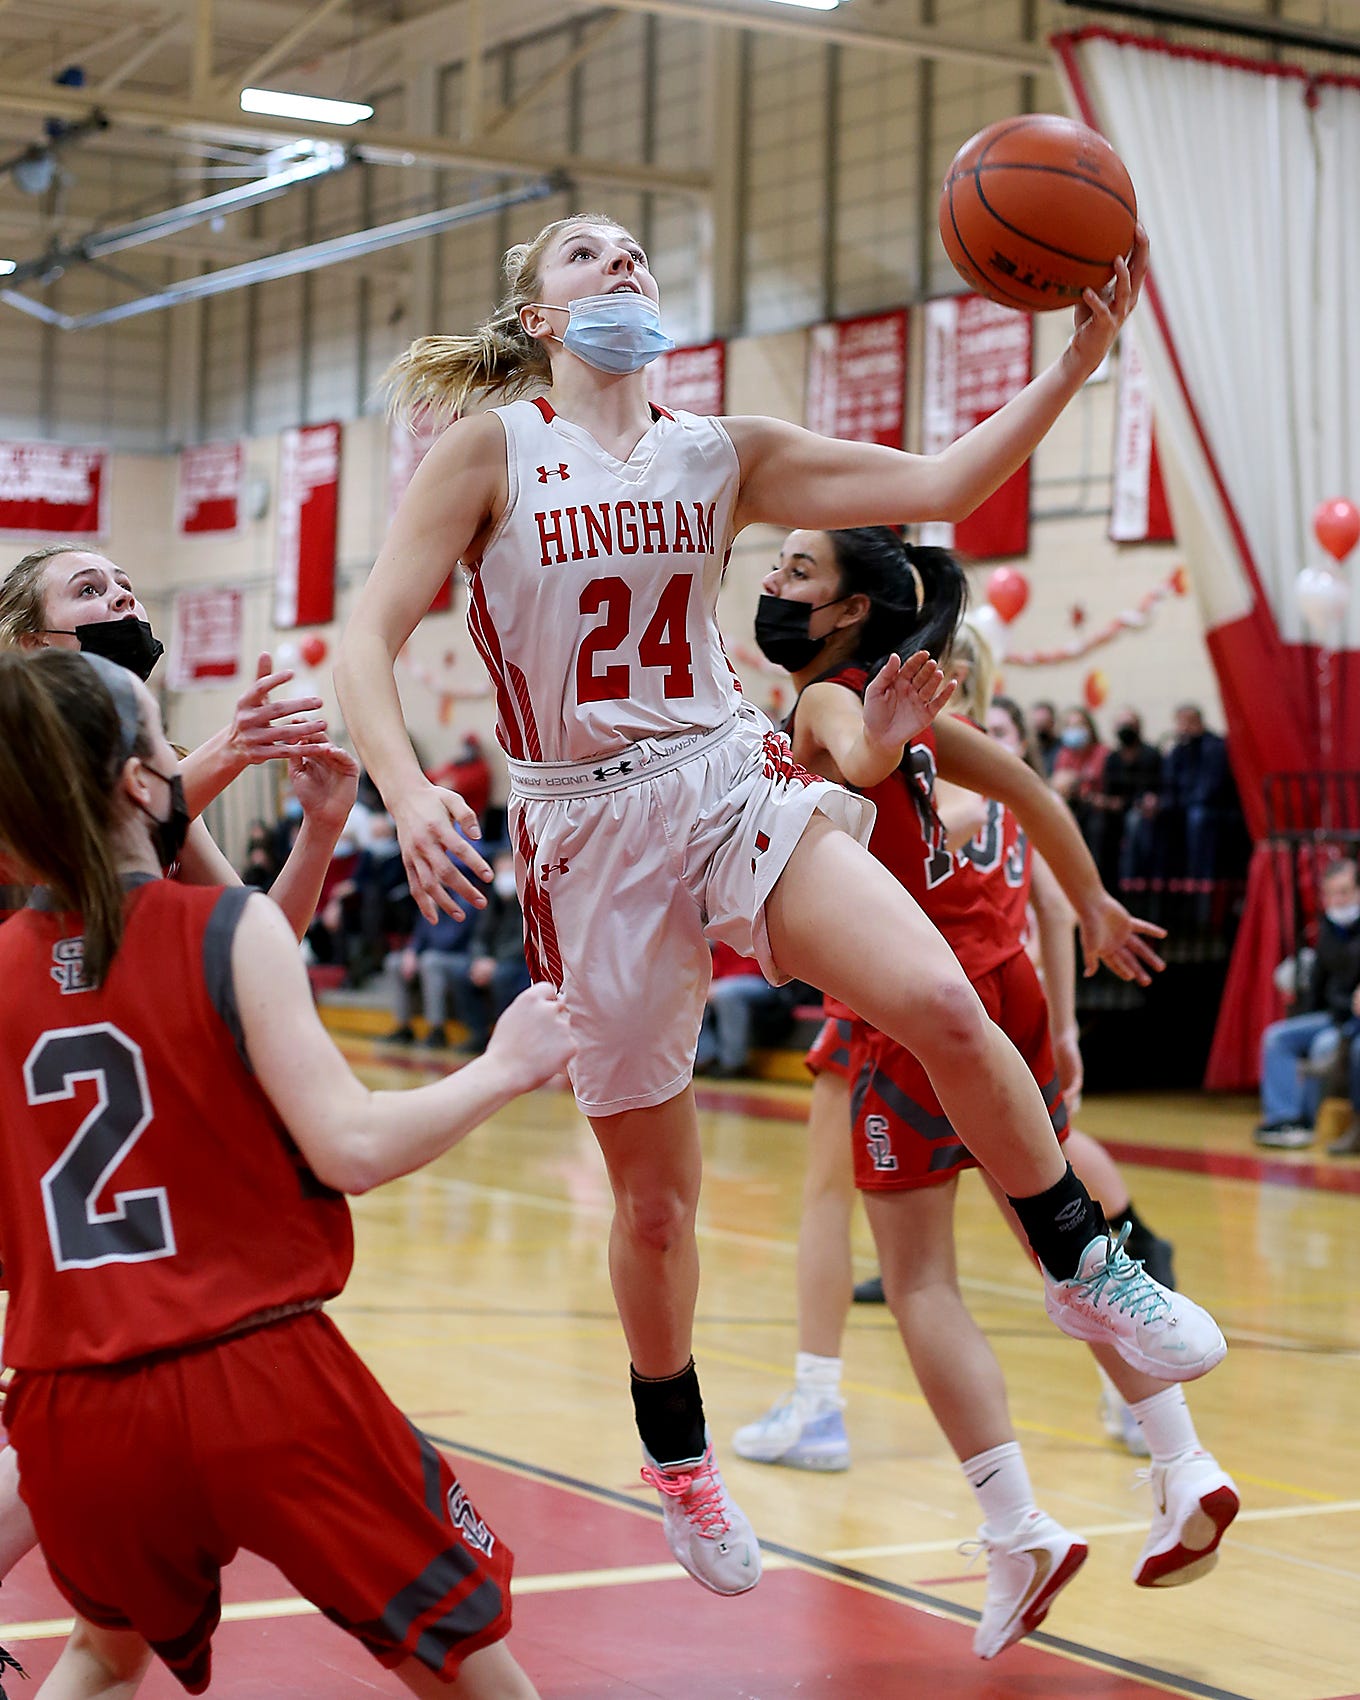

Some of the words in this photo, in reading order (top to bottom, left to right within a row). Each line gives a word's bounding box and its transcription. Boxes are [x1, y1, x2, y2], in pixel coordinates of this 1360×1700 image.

[534, 500, 717, 567] HINGHAM
[576, 574, 694, 705] 24
[23, 1021, 177, 1272] 2
